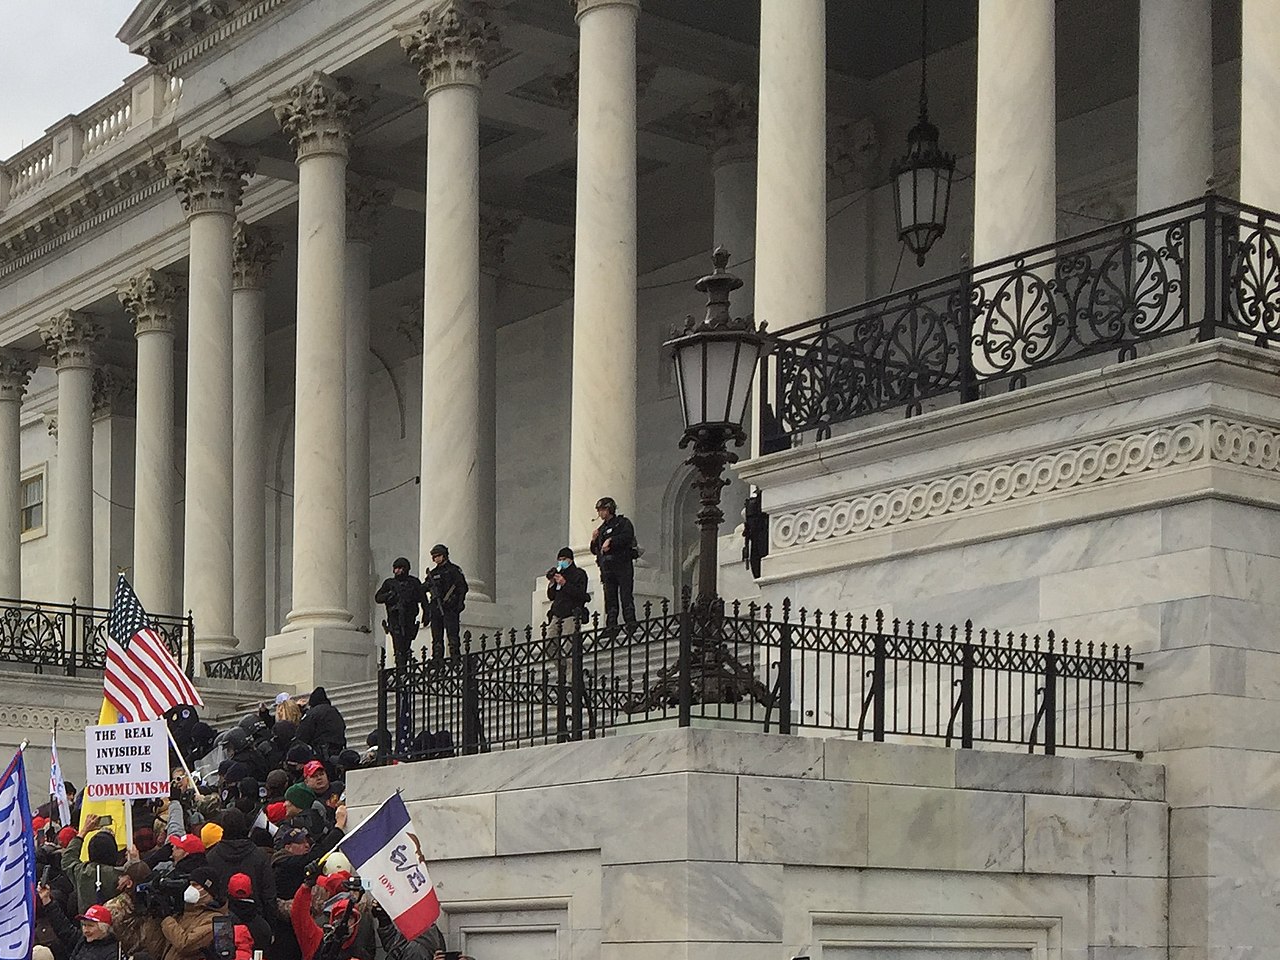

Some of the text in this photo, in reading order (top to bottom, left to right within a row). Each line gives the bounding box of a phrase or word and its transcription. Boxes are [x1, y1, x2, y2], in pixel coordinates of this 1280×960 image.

[95, 727, 153, 741] THE REAL
[97, 745, 151, 759] INVISIBLE
[95, 762, 152, 775] ENEMY IS
[87, 781, 170, 797] COMMUNISM
[378, 874, 396, 896] IOWA
